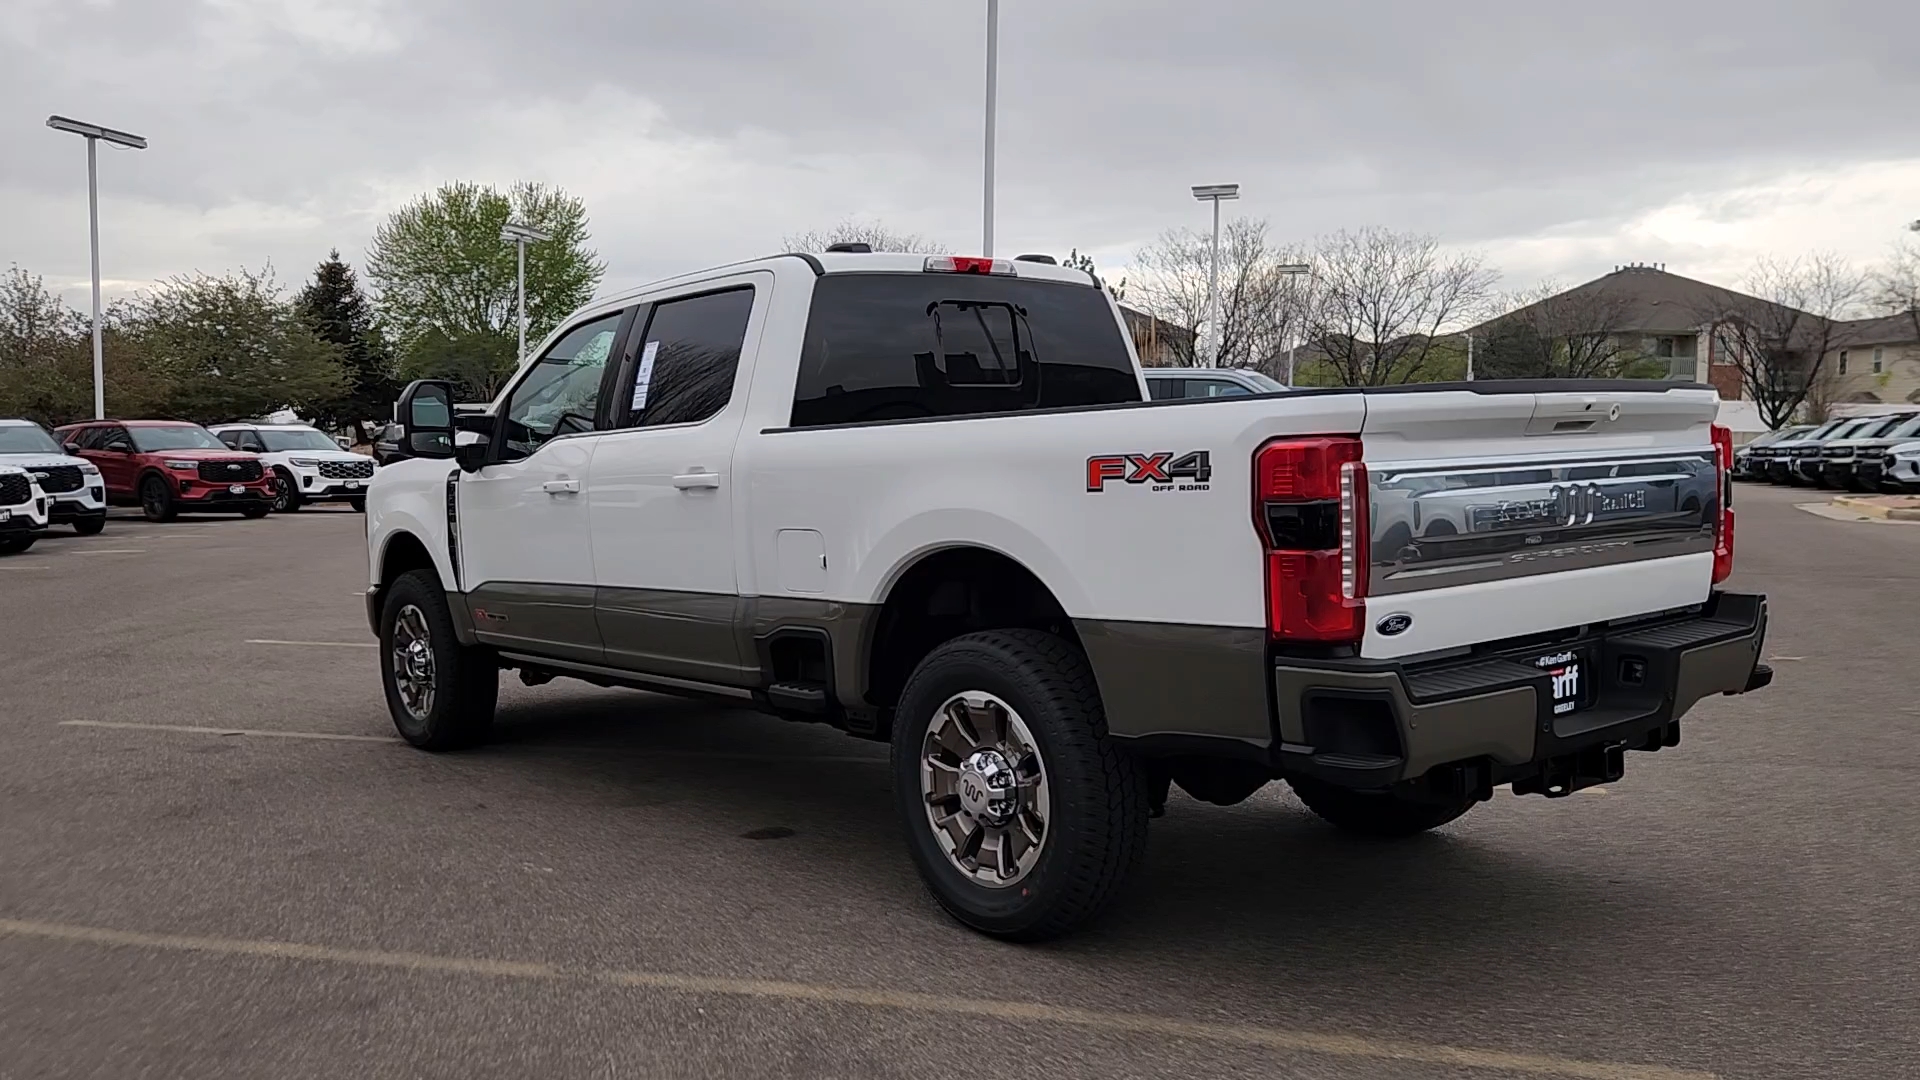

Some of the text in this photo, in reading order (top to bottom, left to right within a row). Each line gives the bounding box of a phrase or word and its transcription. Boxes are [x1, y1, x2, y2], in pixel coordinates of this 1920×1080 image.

[1087, 451, 1211, 492] FX4
[1601, 490, 1646, 511] RANCH
[1552, 664, 1578, 699] arff
